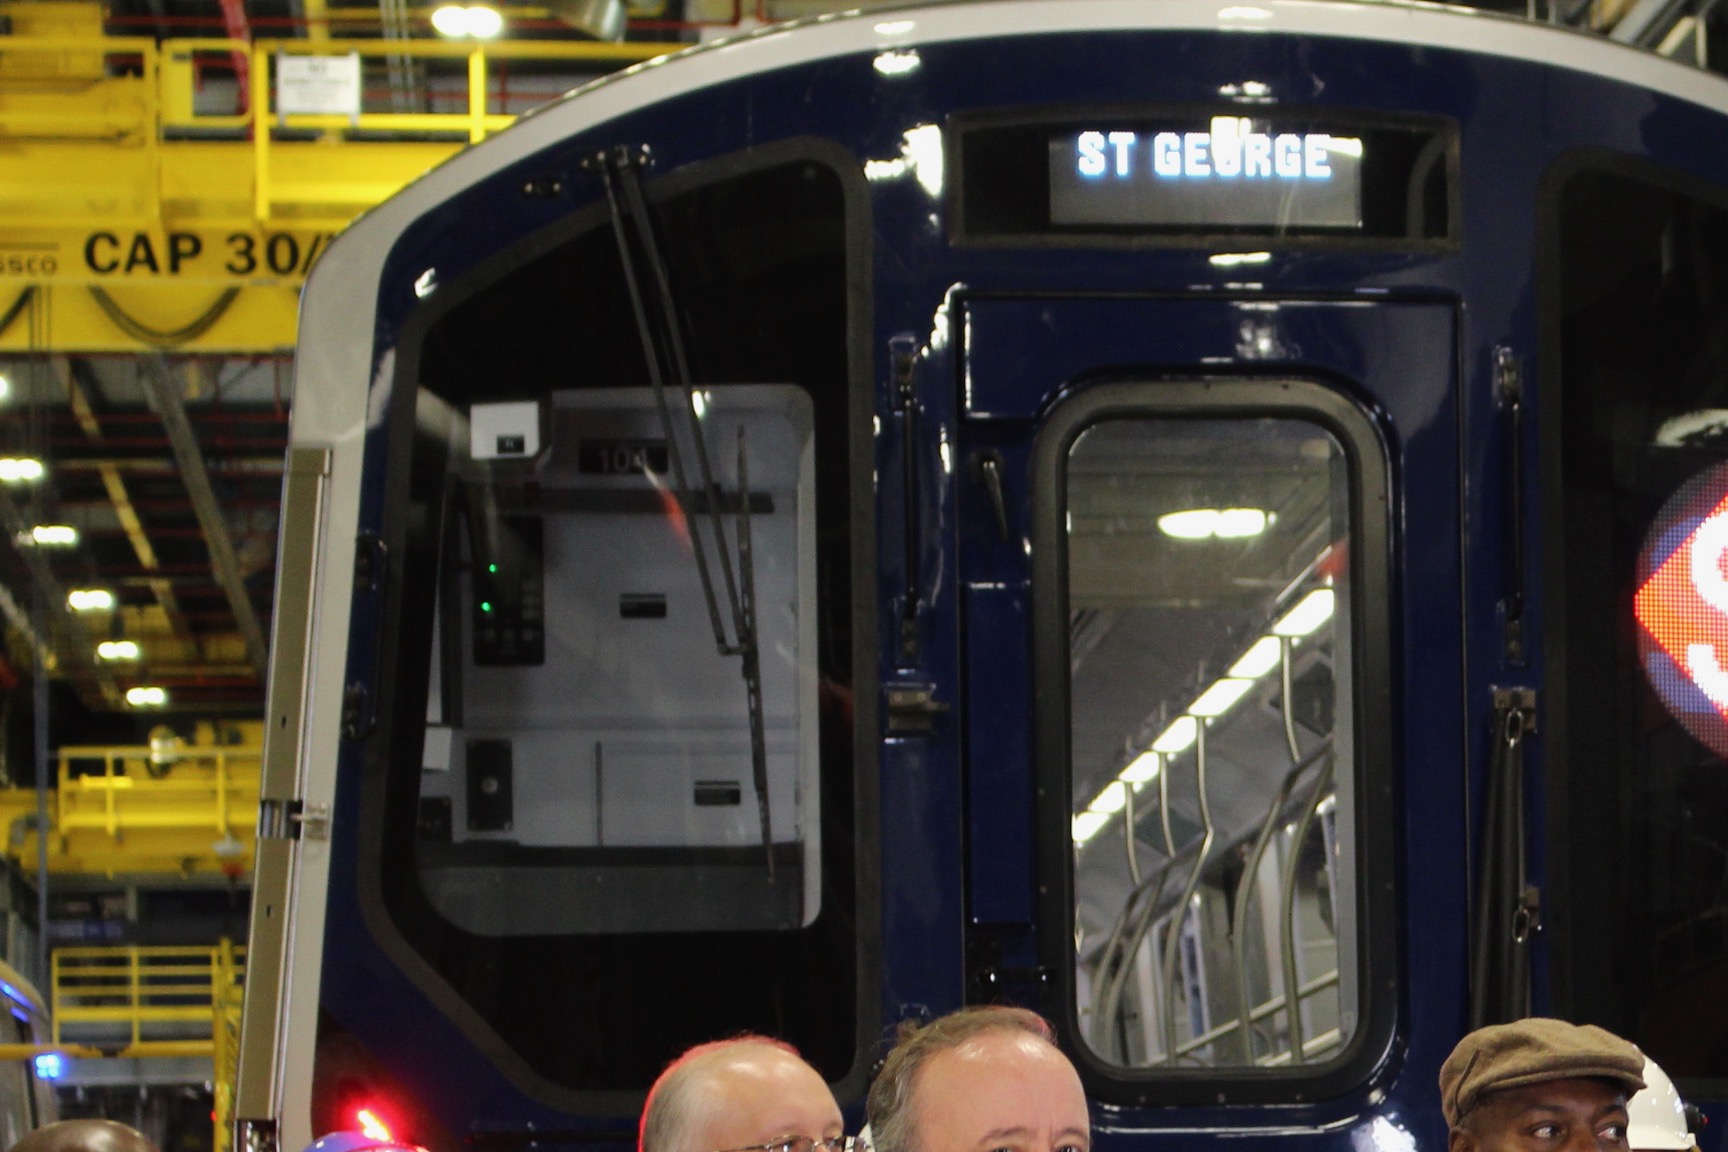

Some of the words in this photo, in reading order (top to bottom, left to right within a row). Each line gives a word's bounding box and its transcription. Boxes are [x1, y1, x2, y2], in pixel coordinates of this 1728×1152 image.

[1078, 131, 1135, 177] ST
[1154, 131, 1332, 178] GEORGE
[84, 231, 203, 275] CAP
[226, 231, 337, 275] 30/
